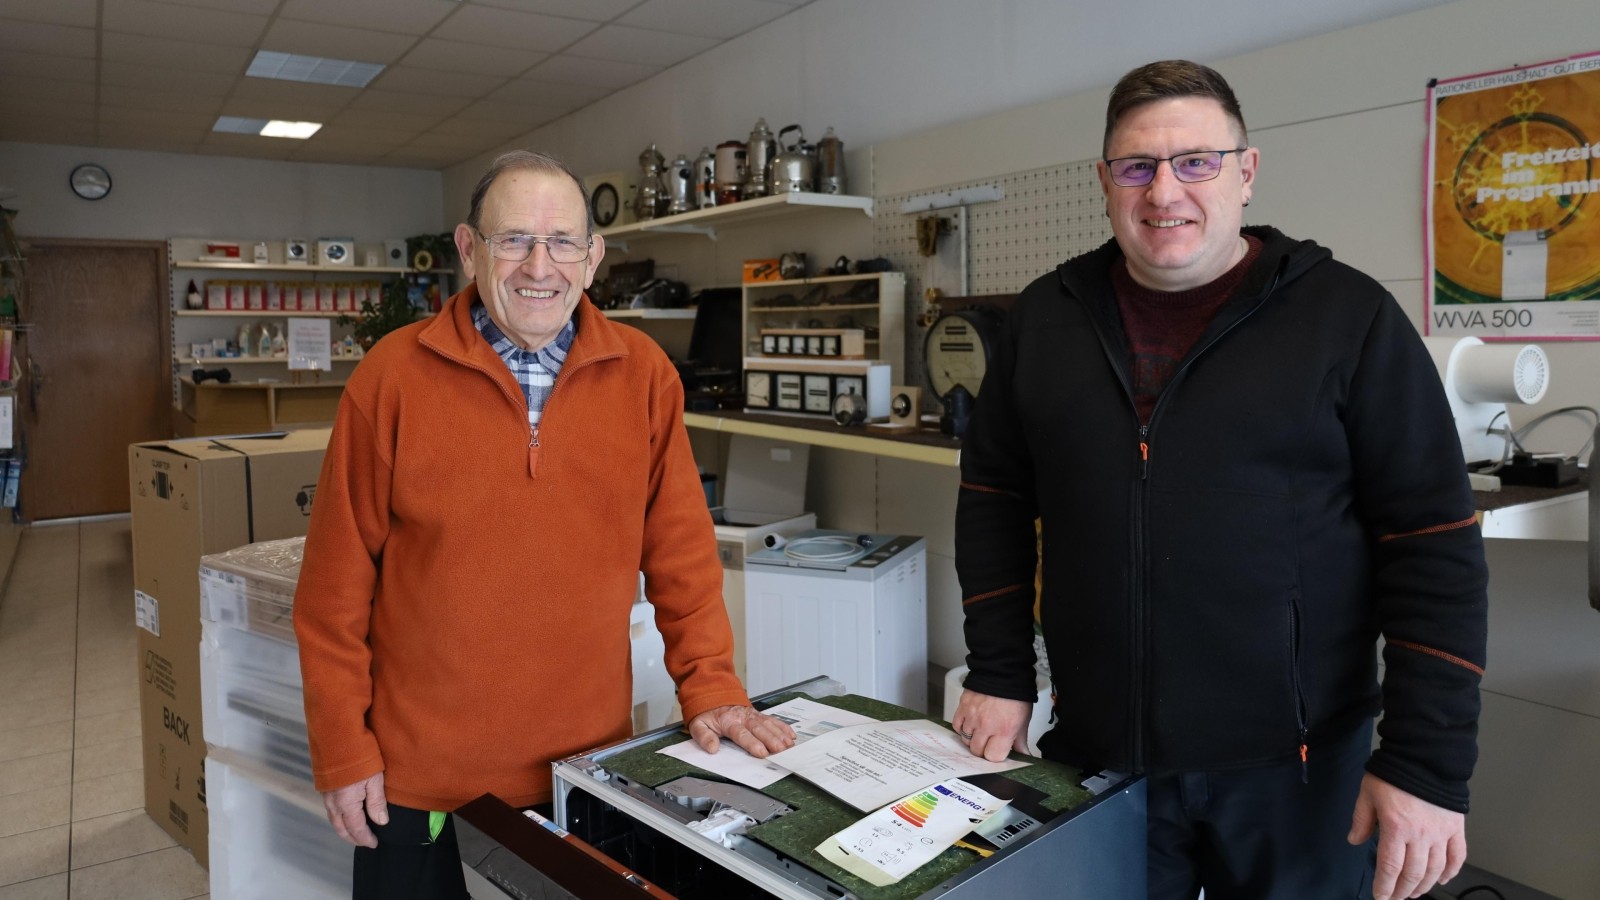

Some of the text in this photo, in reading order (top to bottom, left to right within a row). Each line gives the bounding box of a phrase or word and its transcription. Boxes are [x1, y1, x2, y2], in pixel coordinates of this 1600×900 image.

[1435, 77, 1496, 95] RATIONELLER
[1498, 67, 1548, 84] HAUSHALT
[1553, 62, 1576, 75] GUT
[1502, 168, 1535, 185] im
[1433, 308, 1532, 329] WVA 500
[163, 705, 190, 745] BACK
[950, 792, 982, 811] ENERG
